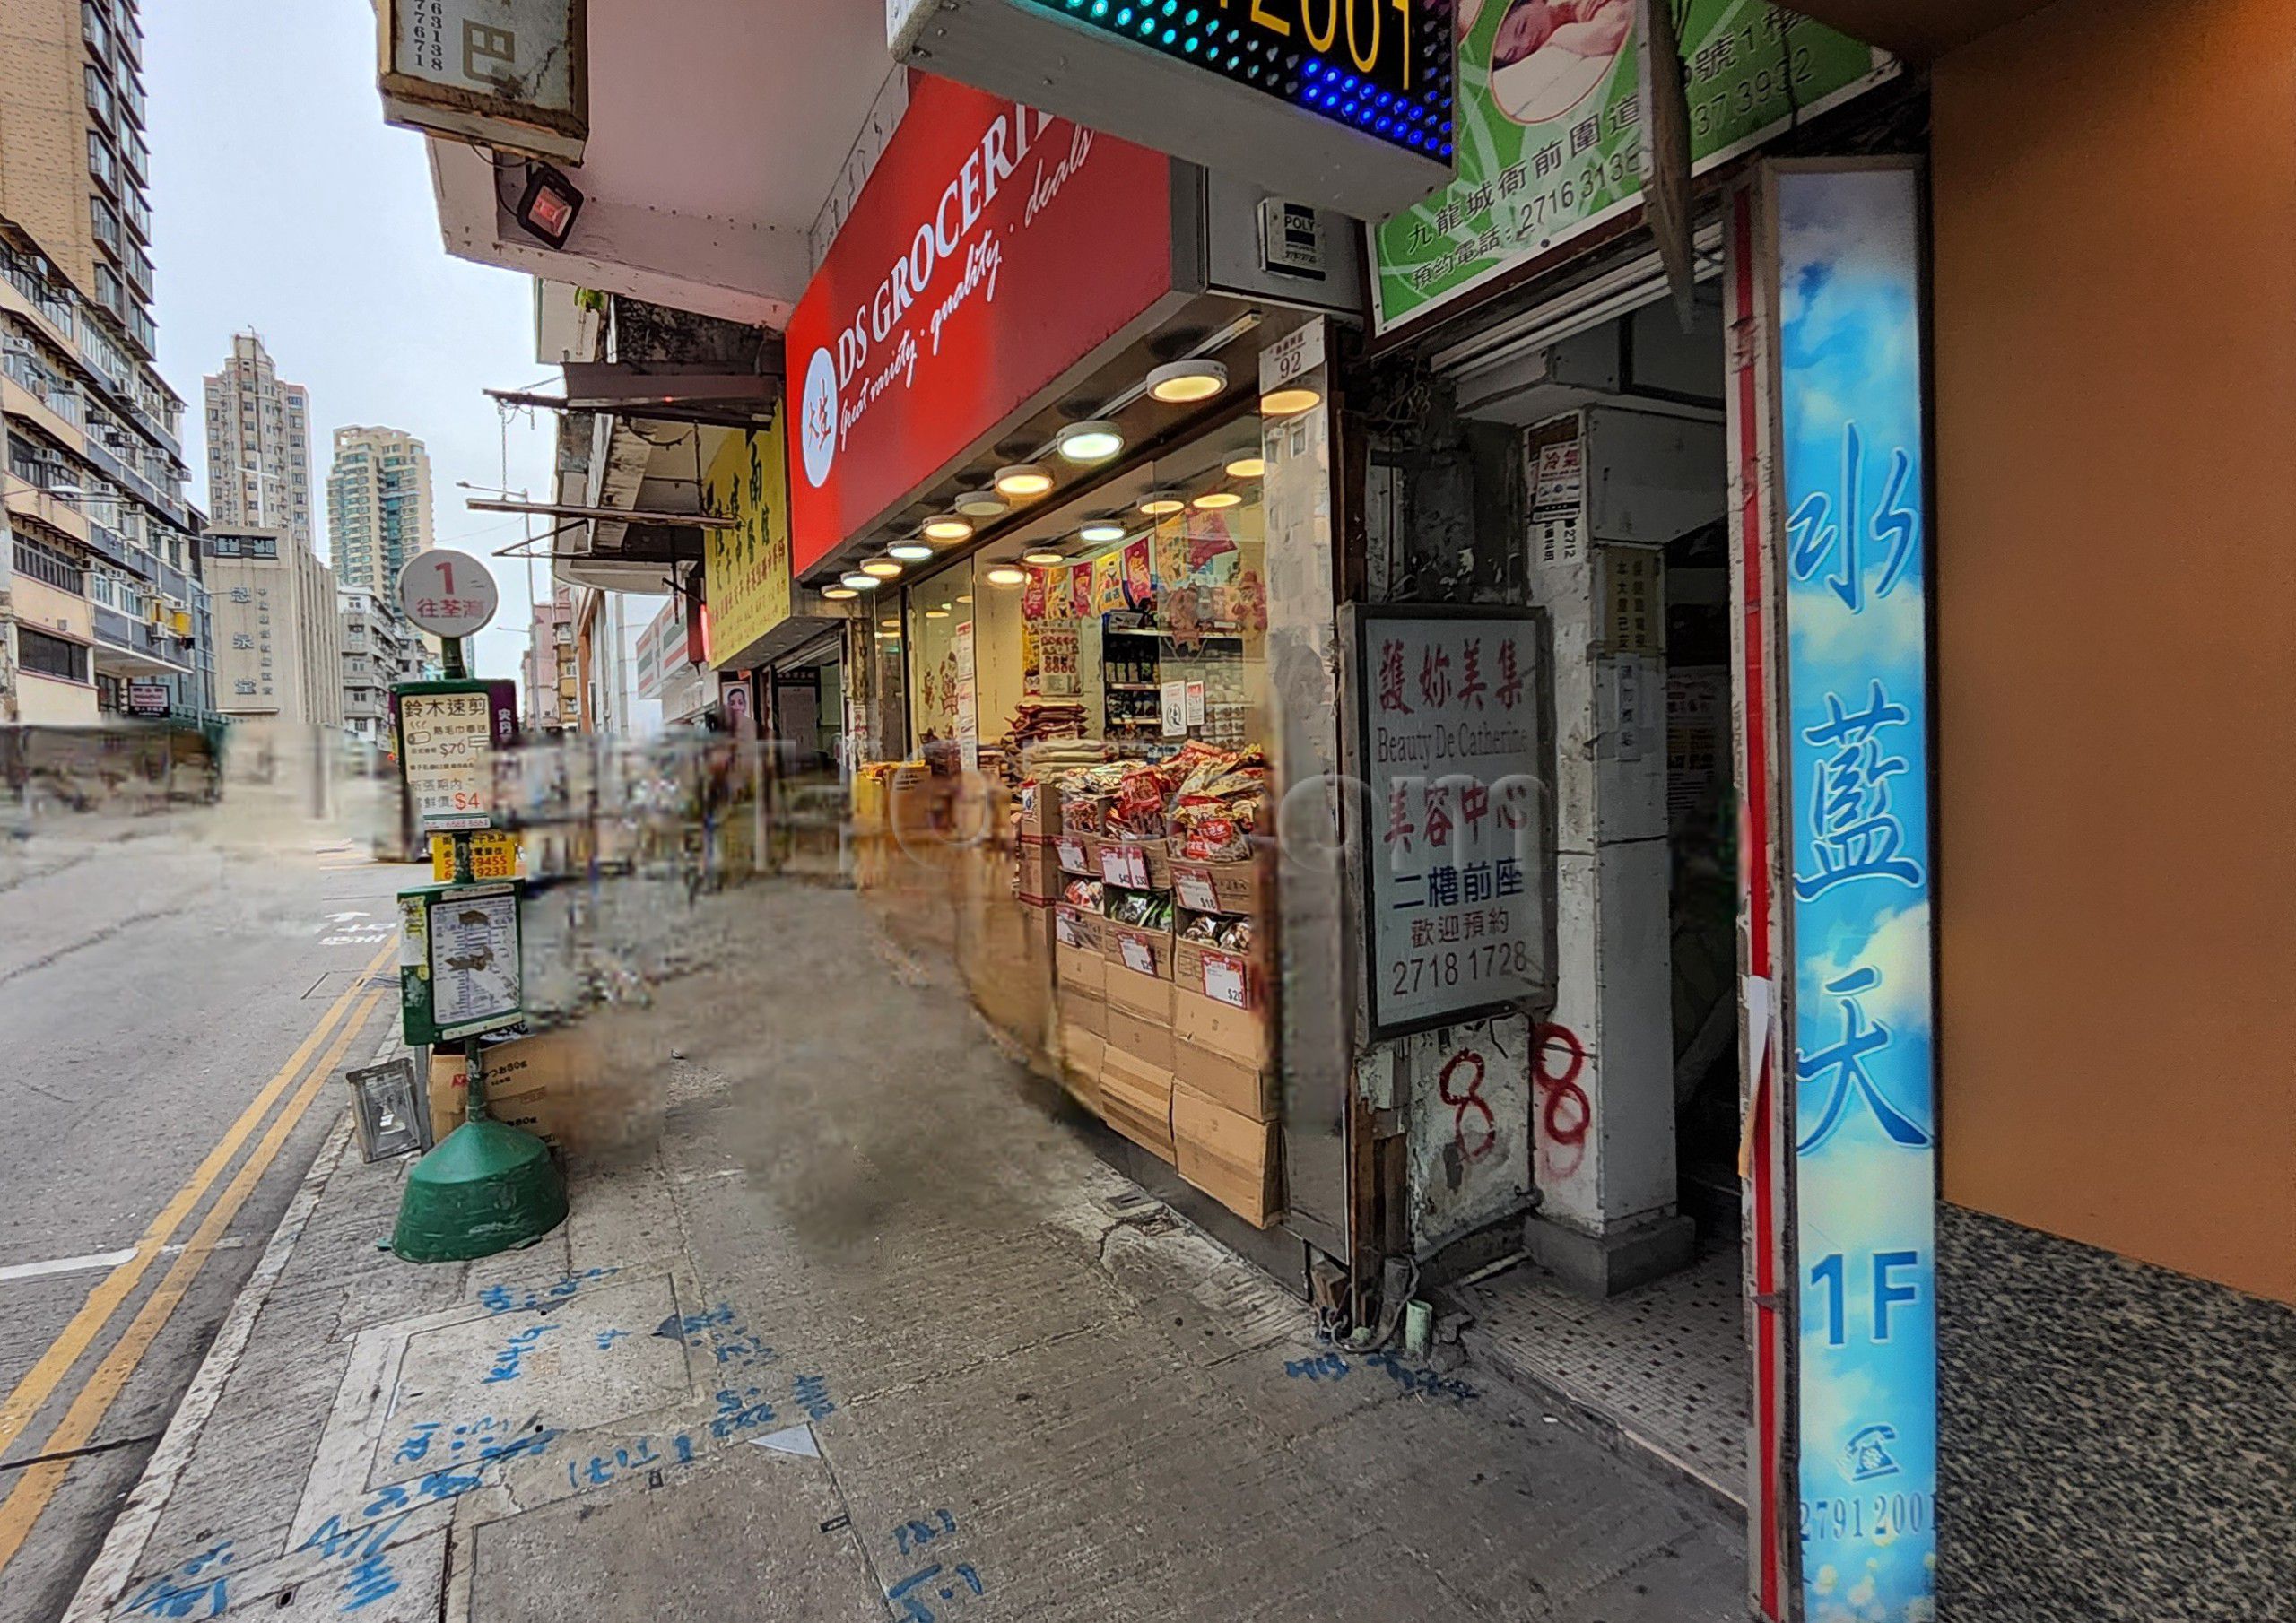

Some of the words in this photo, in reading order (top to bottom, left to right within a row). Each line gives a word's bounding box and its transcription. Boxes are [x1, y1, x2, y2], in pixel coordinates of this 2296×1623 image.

[1408, 93, 1639, 254] 九龍城衙前圍道
[1284, 216, 1315, 231] POLY
[1280, 351, 1301, 378] 92
[434, 561, 455, 595] 1
[404, 698, 487, 718] 鈴木速剪
[1378, 726, 1432, 770] Beauty
[1435, 723, 1455, 759] De
[1787, 421, 1935, 1151] 水藍天
[1384, 777, 1527, 854] 美容中心
[1393, 857, 1524, 910] 二樓前座
[1411, 908, 1509, 948] 歡迎預約
[1392, 952, 1459, 996] 2718
[1468, 940, 1526, 980] 1728
[1810, 1250, 1918, 1345] 1F
